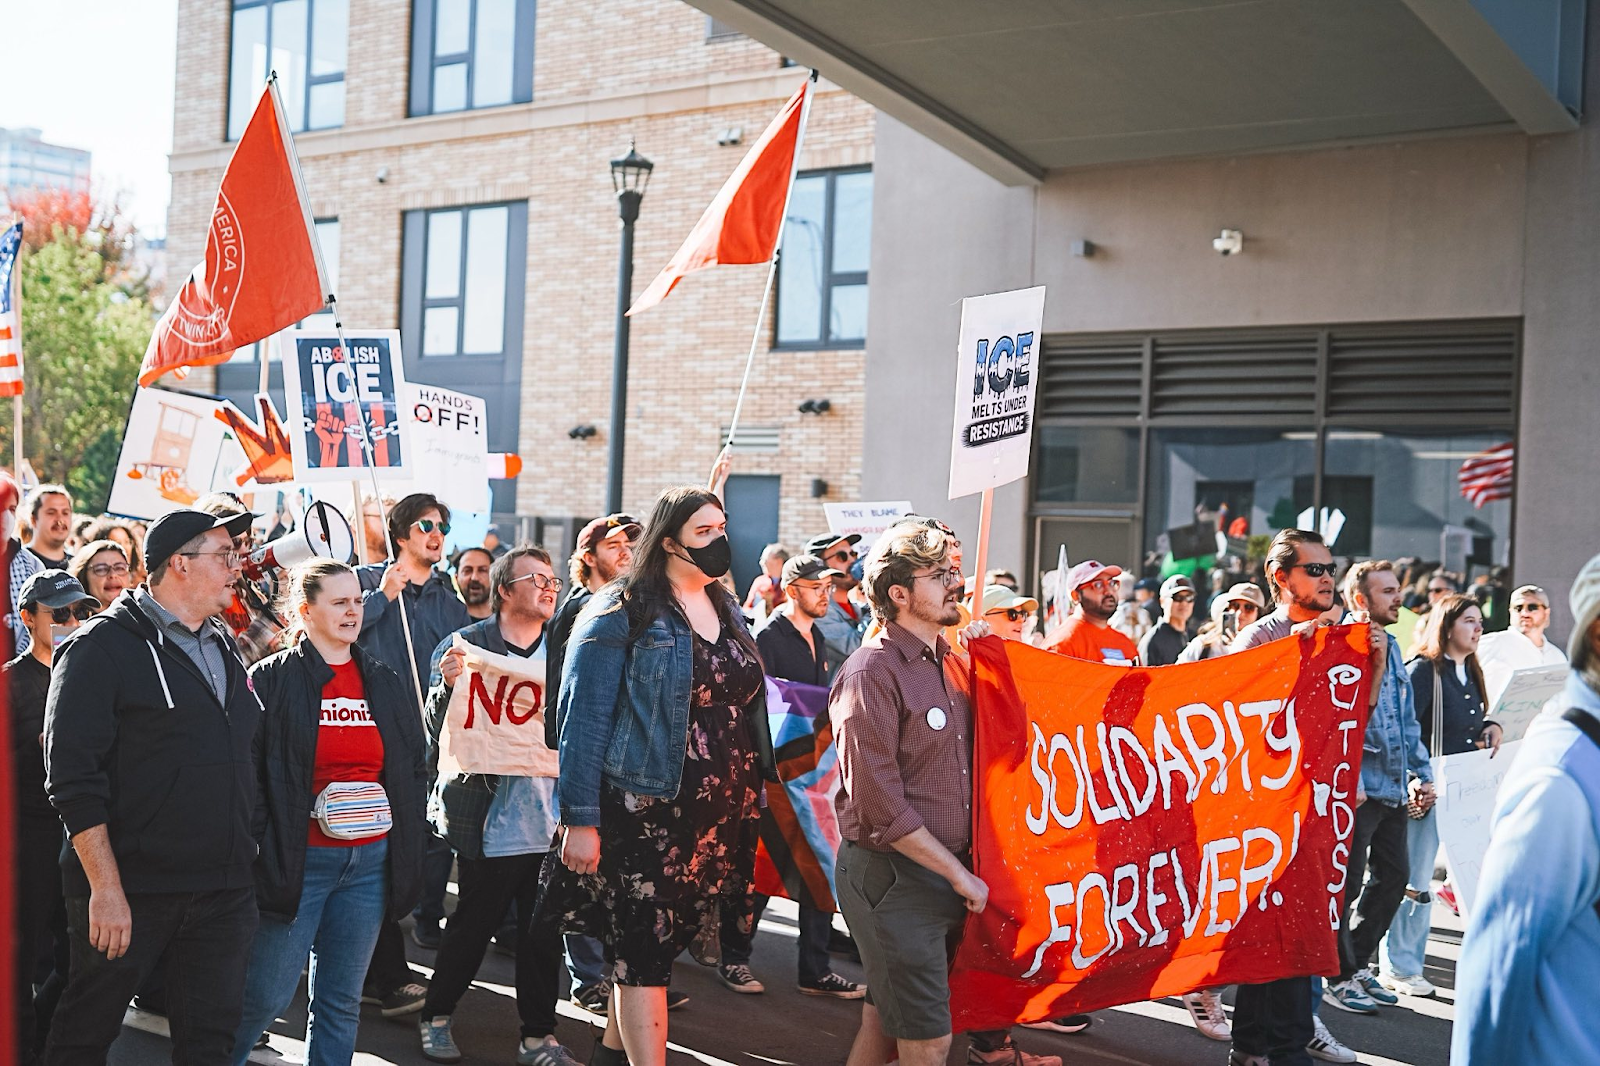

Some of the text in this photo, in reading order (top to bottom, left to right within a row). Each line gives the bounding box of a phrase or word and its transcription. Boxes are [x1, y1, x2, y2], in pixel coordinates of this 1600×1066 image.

[179, 316, 205, 339] TWIN
[311, 346, 380, 363] ABOLISH
[973, 331, 1034, 400] ICE
[312, 362, 384, 403] ICE
[420, 389, 473, 411] HANDS
[971, 395, 1027, 420] MELTS UNDER
[414, 403, 479, 435] OFF!
[969, 414, 1025, 443] RESISTANCE
[841, 507, 899, 519] THEY BLAME
[464, 671, 542, 729] NO
[1025, 697, 1301, 835] SOLIDARITY
[1021, 811, 1301, 978] FOREVER!
